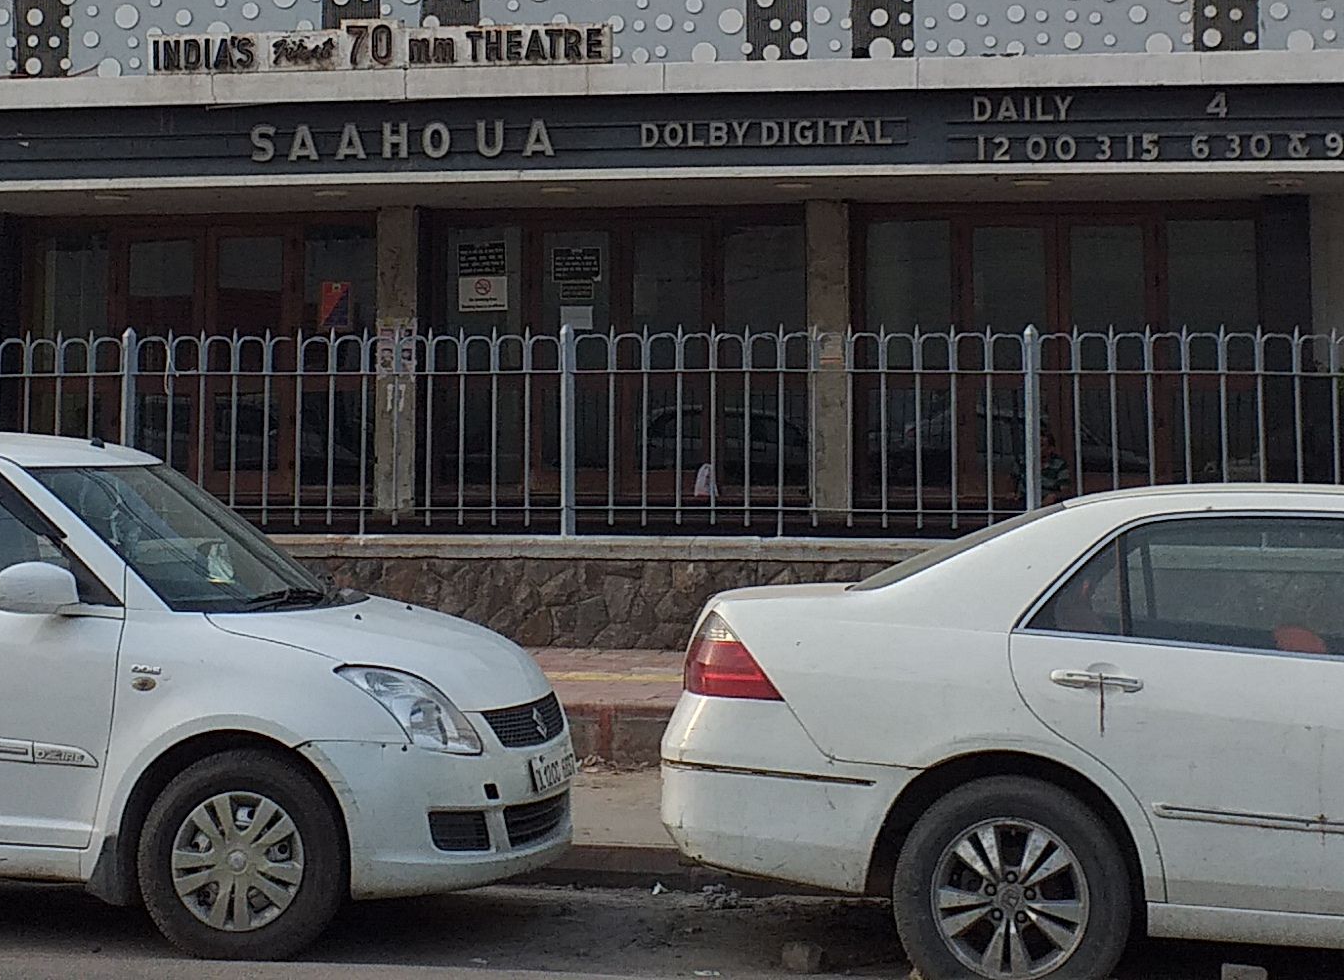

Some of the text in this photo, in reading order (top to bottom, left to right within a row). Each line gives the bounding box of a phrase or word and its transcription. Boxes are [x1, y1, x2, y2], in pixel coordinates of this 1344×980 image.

[153, 36, 255, 71] INDIA'S
[346, 24, 394, 66] 70
[408, 36, 456, 64] mm
[465, 27, 604, 62] THEATRE
[972, 95, 1074, 121] DAILY
[1206, 91, 1228, 118] 4
[250, 123, 450, 163] SAAHO
[640, 117, 893, 148] DOLBY DIGITAL
